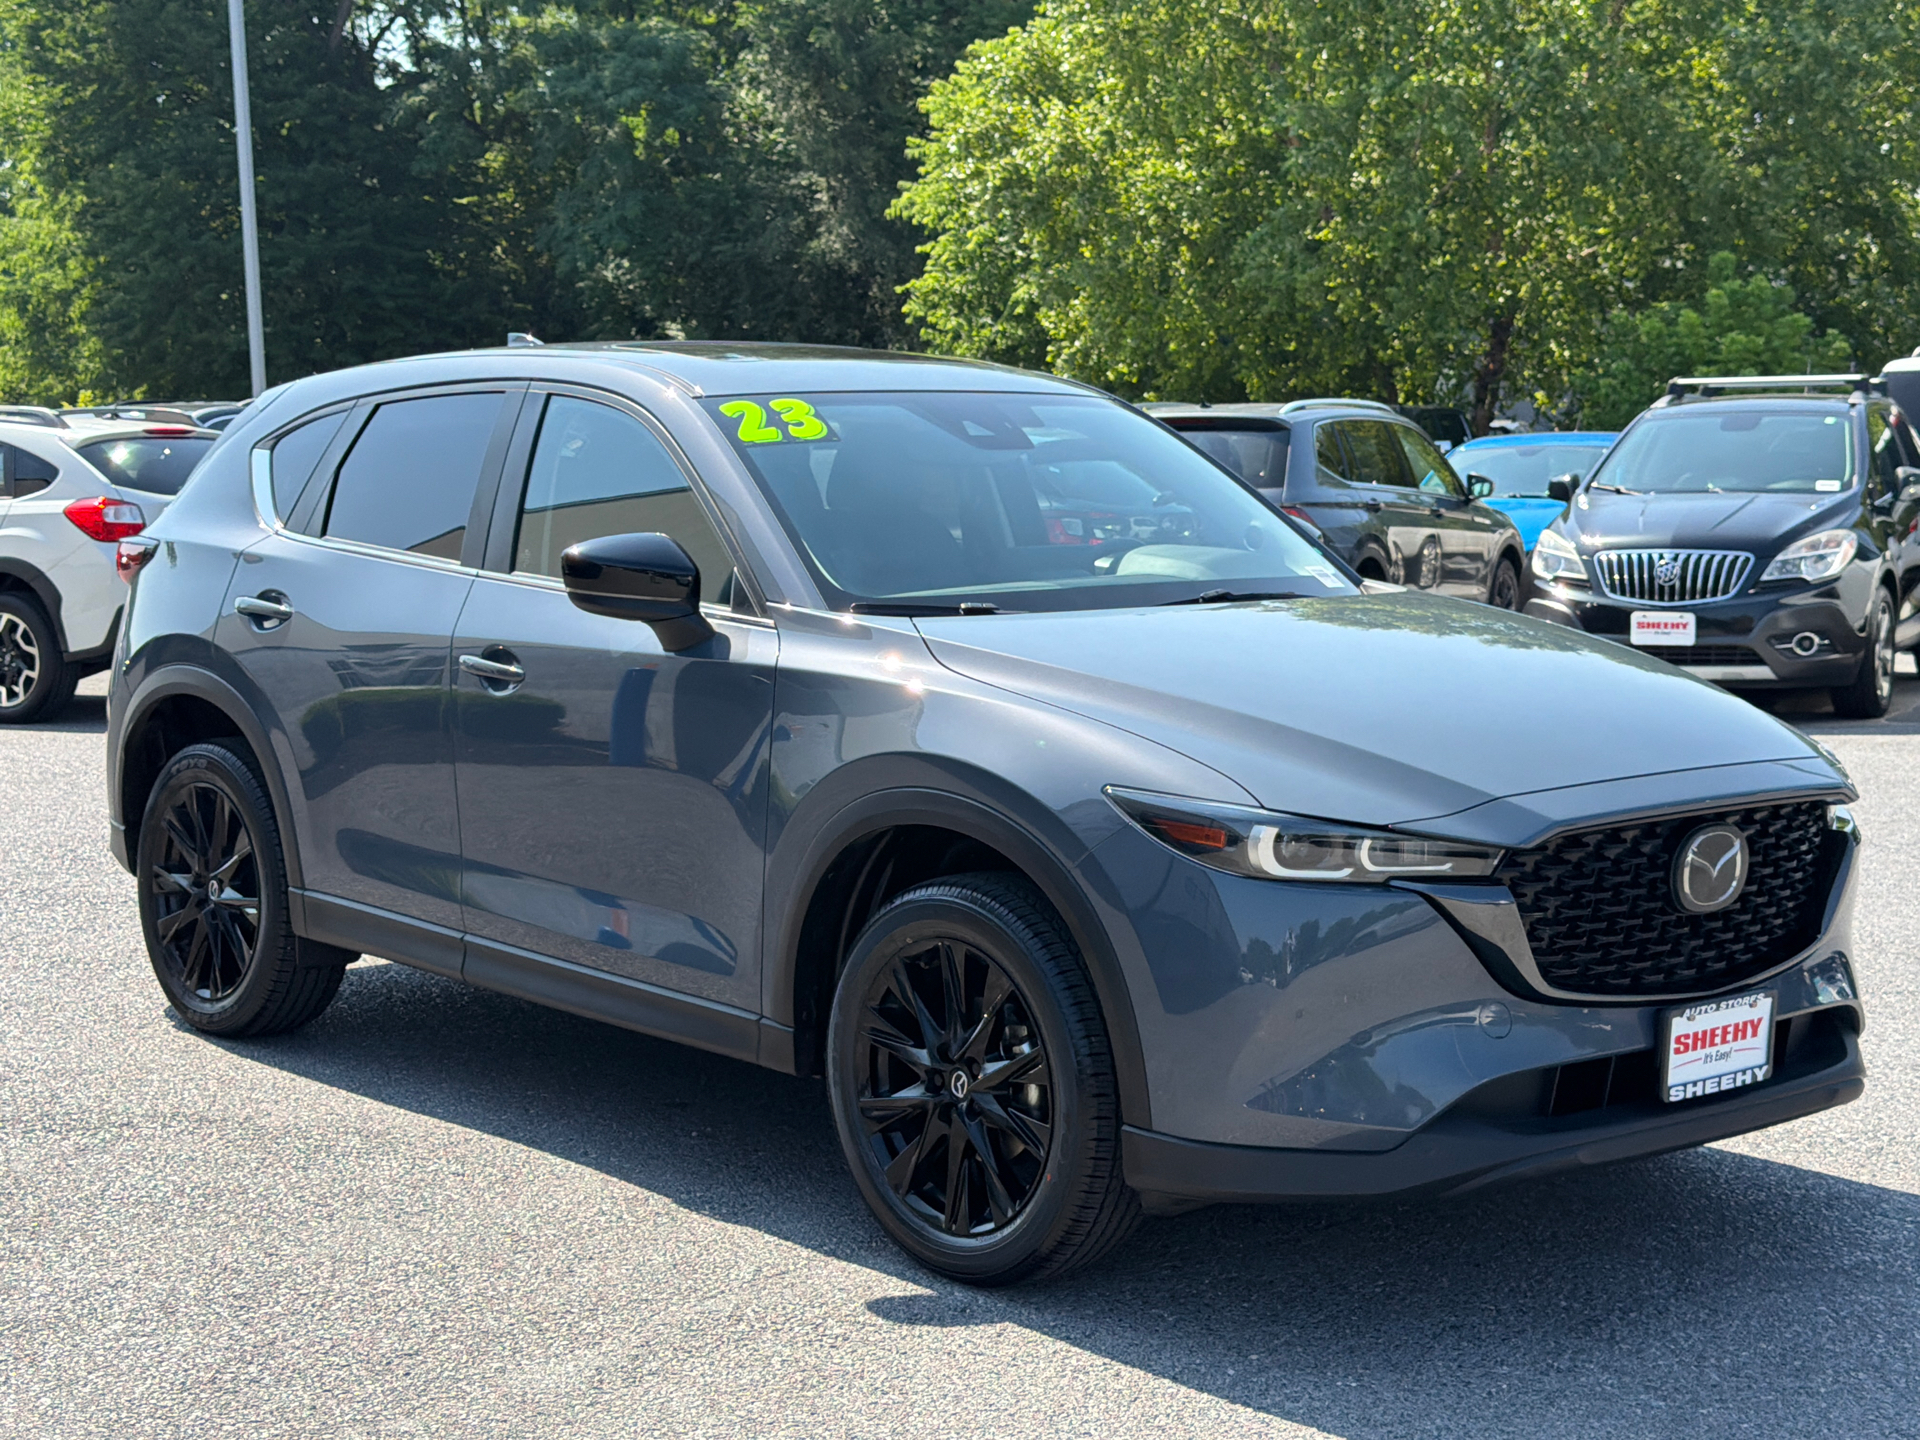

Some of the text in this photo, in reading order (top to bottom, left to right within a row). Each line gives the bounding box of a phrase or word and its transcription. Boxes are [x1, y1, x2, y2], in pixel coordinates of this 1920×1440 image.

[719, 398, 828, 443] 23
[1682, 993, 1766, 1018] AUTO STORES
[1673, 1016, 1764, 1055] SHEEHY
[1703, 1046, 1733, 1064] It's Easy!
[1668, 1065, 1769, 1102] SHEEHY
